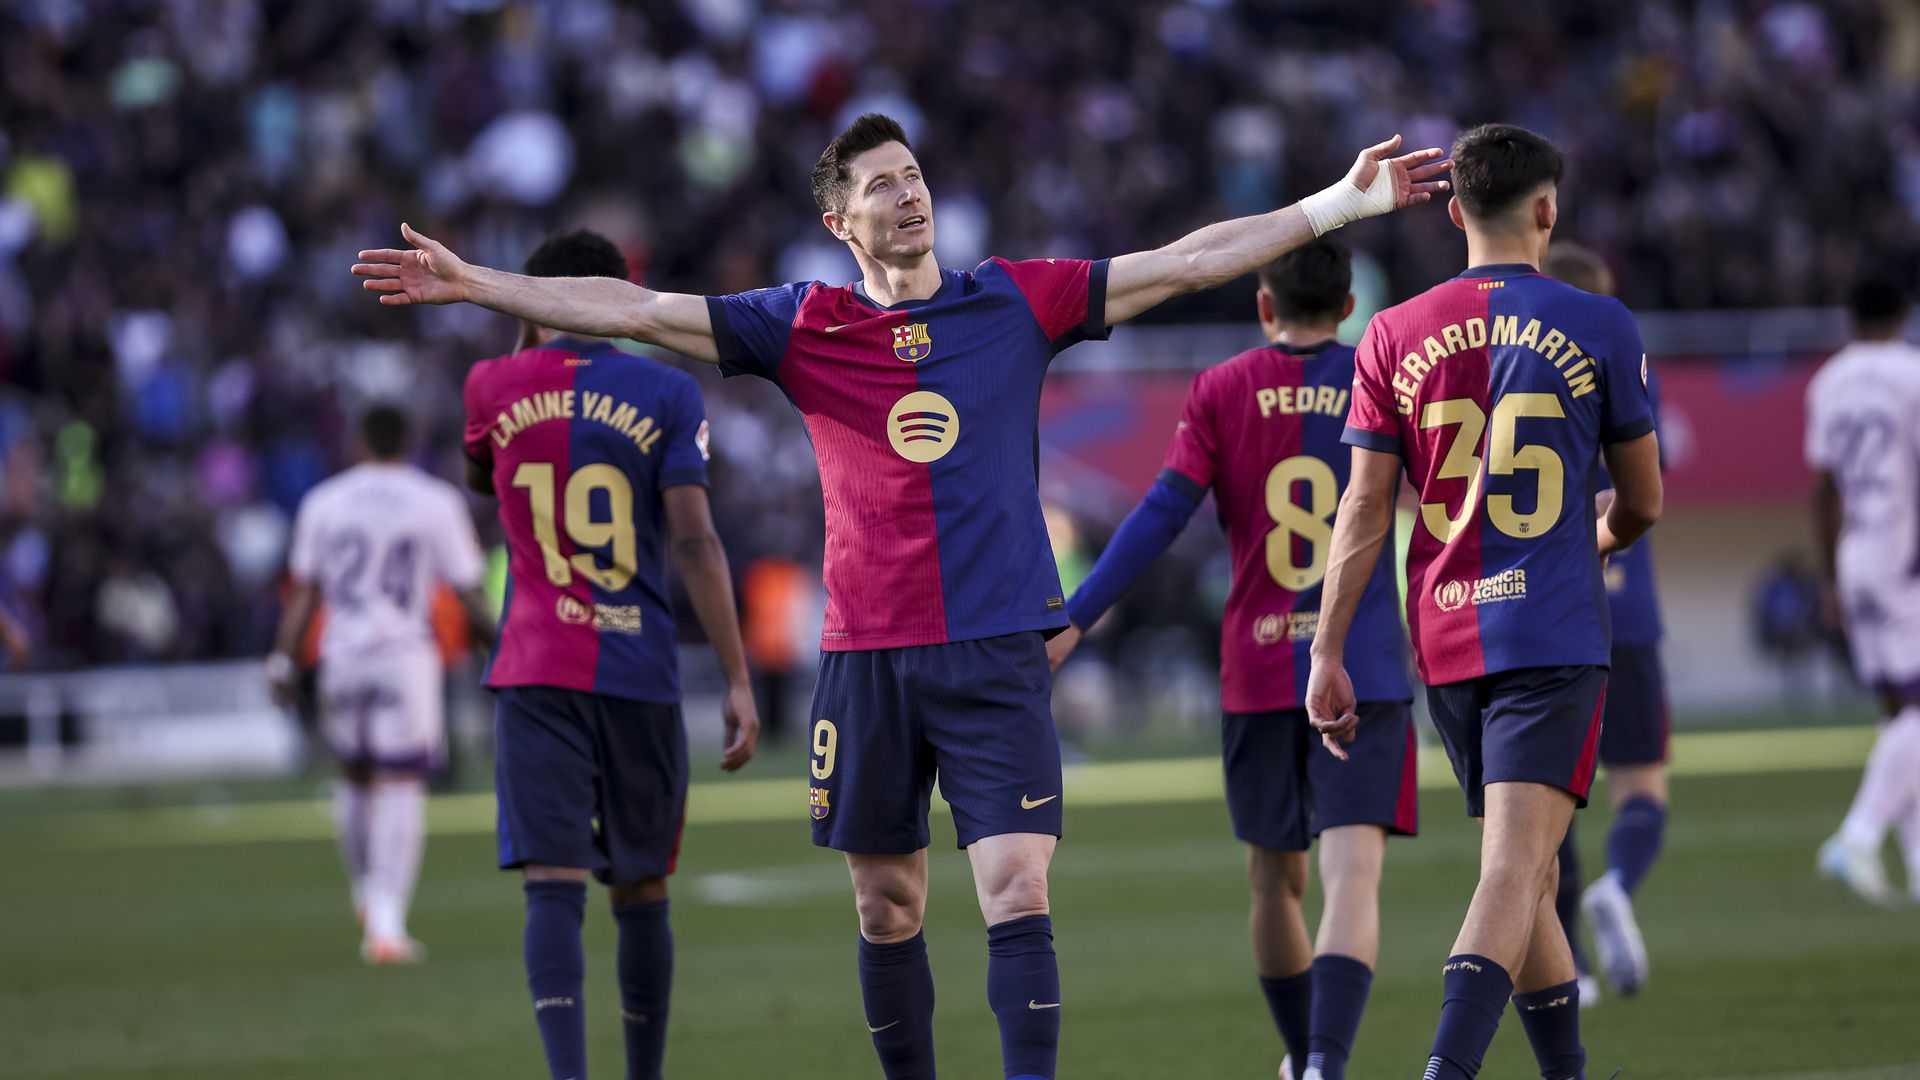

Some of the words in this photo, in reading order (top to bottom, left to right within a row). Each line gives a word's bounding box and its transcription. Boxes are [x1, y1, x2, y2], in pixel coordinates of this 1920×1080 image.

[1256, 385, 1349, 418] PEDRI
[1393, 317, 1487, 416] GERARD
[1491, 315, 1596, 399] MARTÍN
[490, 390, 575, 449] LAMINE
[582, 390, 662, 455] YAMAL
[1419, 393, 1566, 544] 35
[512, 462, 638, 592] 19
[1265, 455, 1338, 591] 8
[328, 527, 418, 615] 24
[1471, 581, 1526, 600] ACNUR
[1473, 569, 1526, 590] UNHCR
[811, 719, 838, 780] 9
